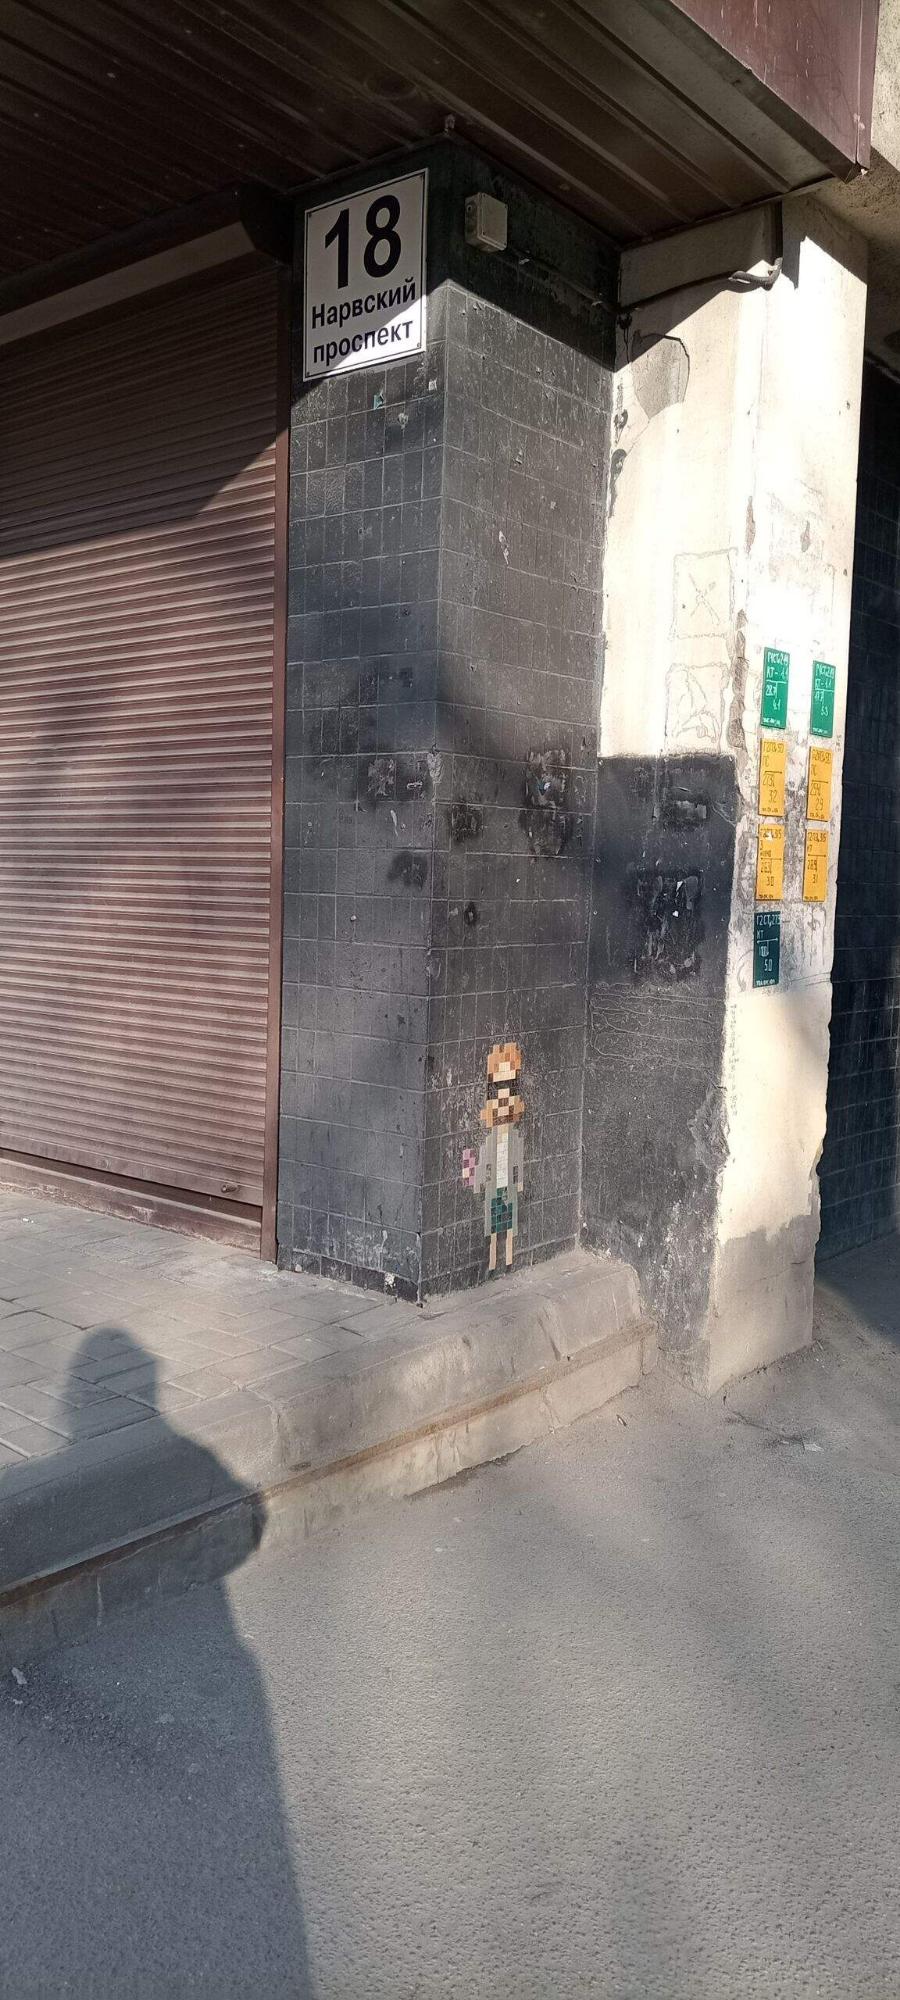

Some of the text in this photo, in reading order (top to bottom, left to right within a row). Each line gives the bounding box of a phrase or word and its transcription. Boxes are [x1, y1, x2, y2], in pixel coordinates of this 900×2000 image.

[324, 194, 402, 290] 18
[311, 277, 416, 329] Нарвский
[313, 320, 413, 366] проспект
